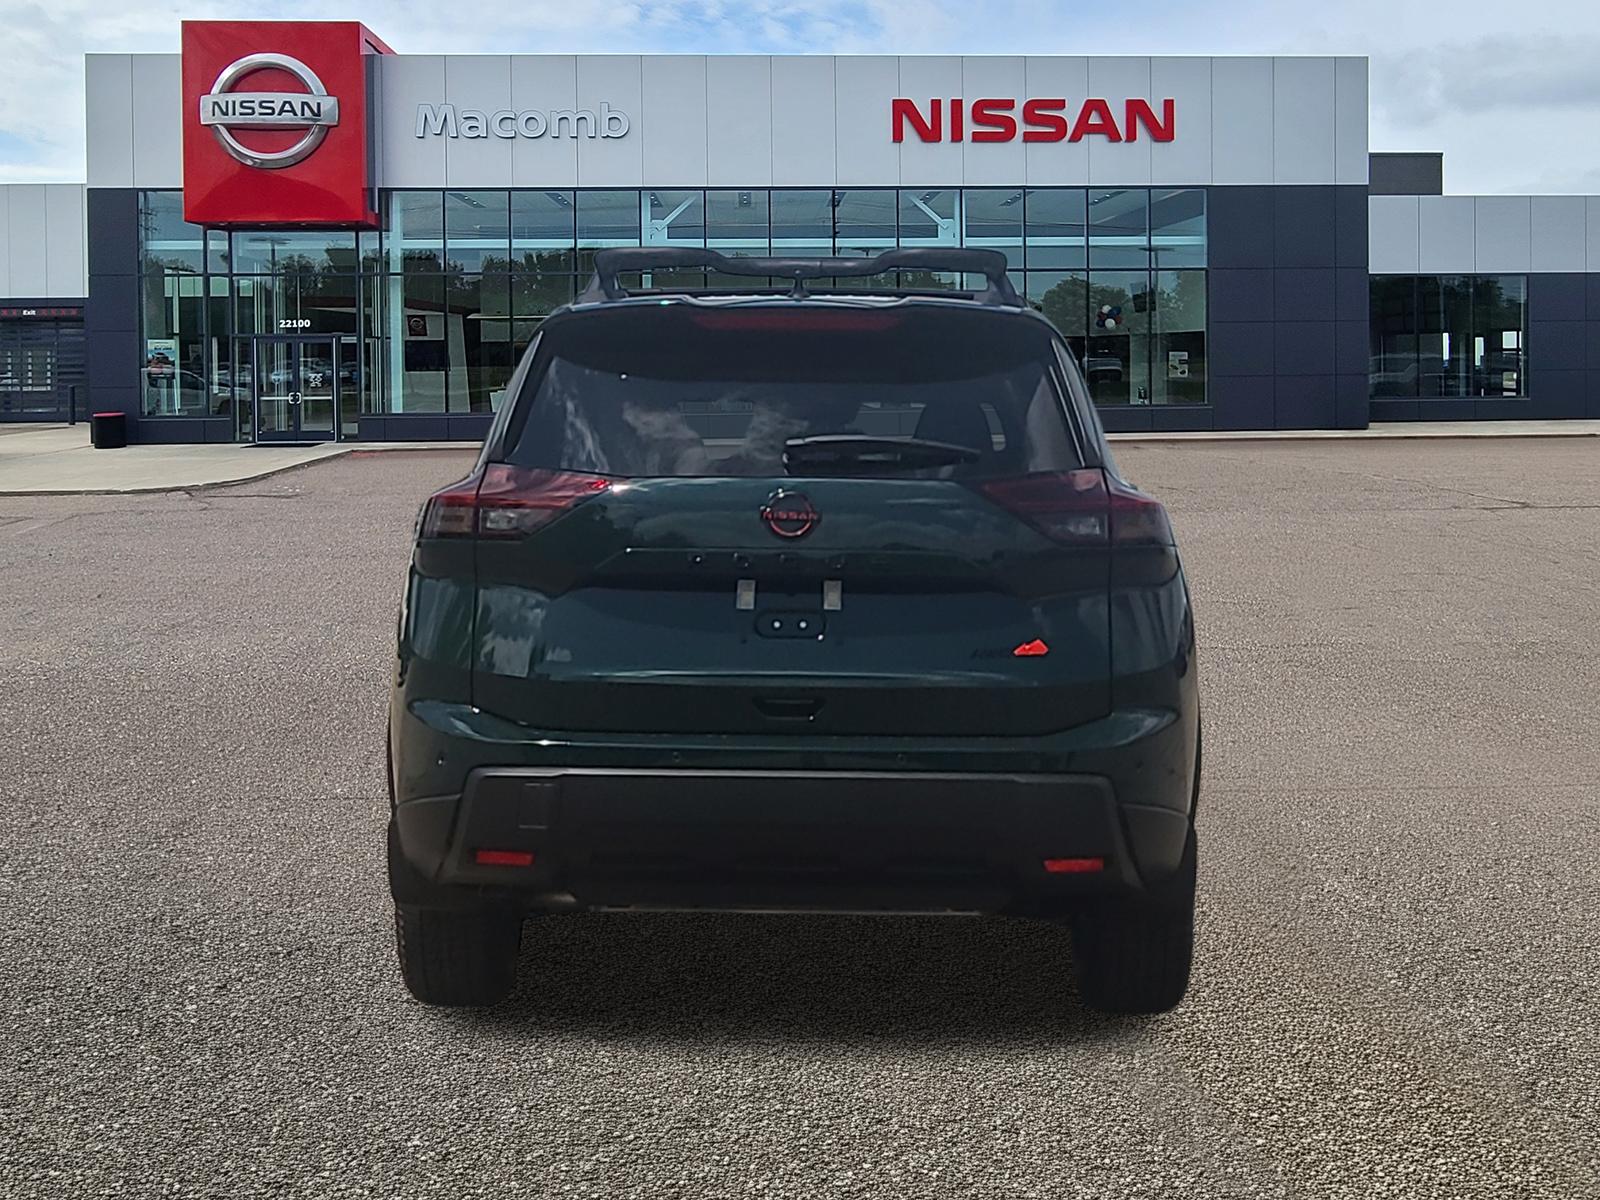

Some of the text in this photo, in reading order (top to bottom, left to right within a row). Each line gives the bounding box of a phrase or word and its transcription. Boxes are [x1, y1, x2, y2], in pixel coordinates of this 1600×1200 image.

[211, 100, 322, 118] NISSAN
[415, 102, 630, 139] Macomb
[892, 98, 1176, 143] NISSAN
[279, 319, 311, 328] 22100
